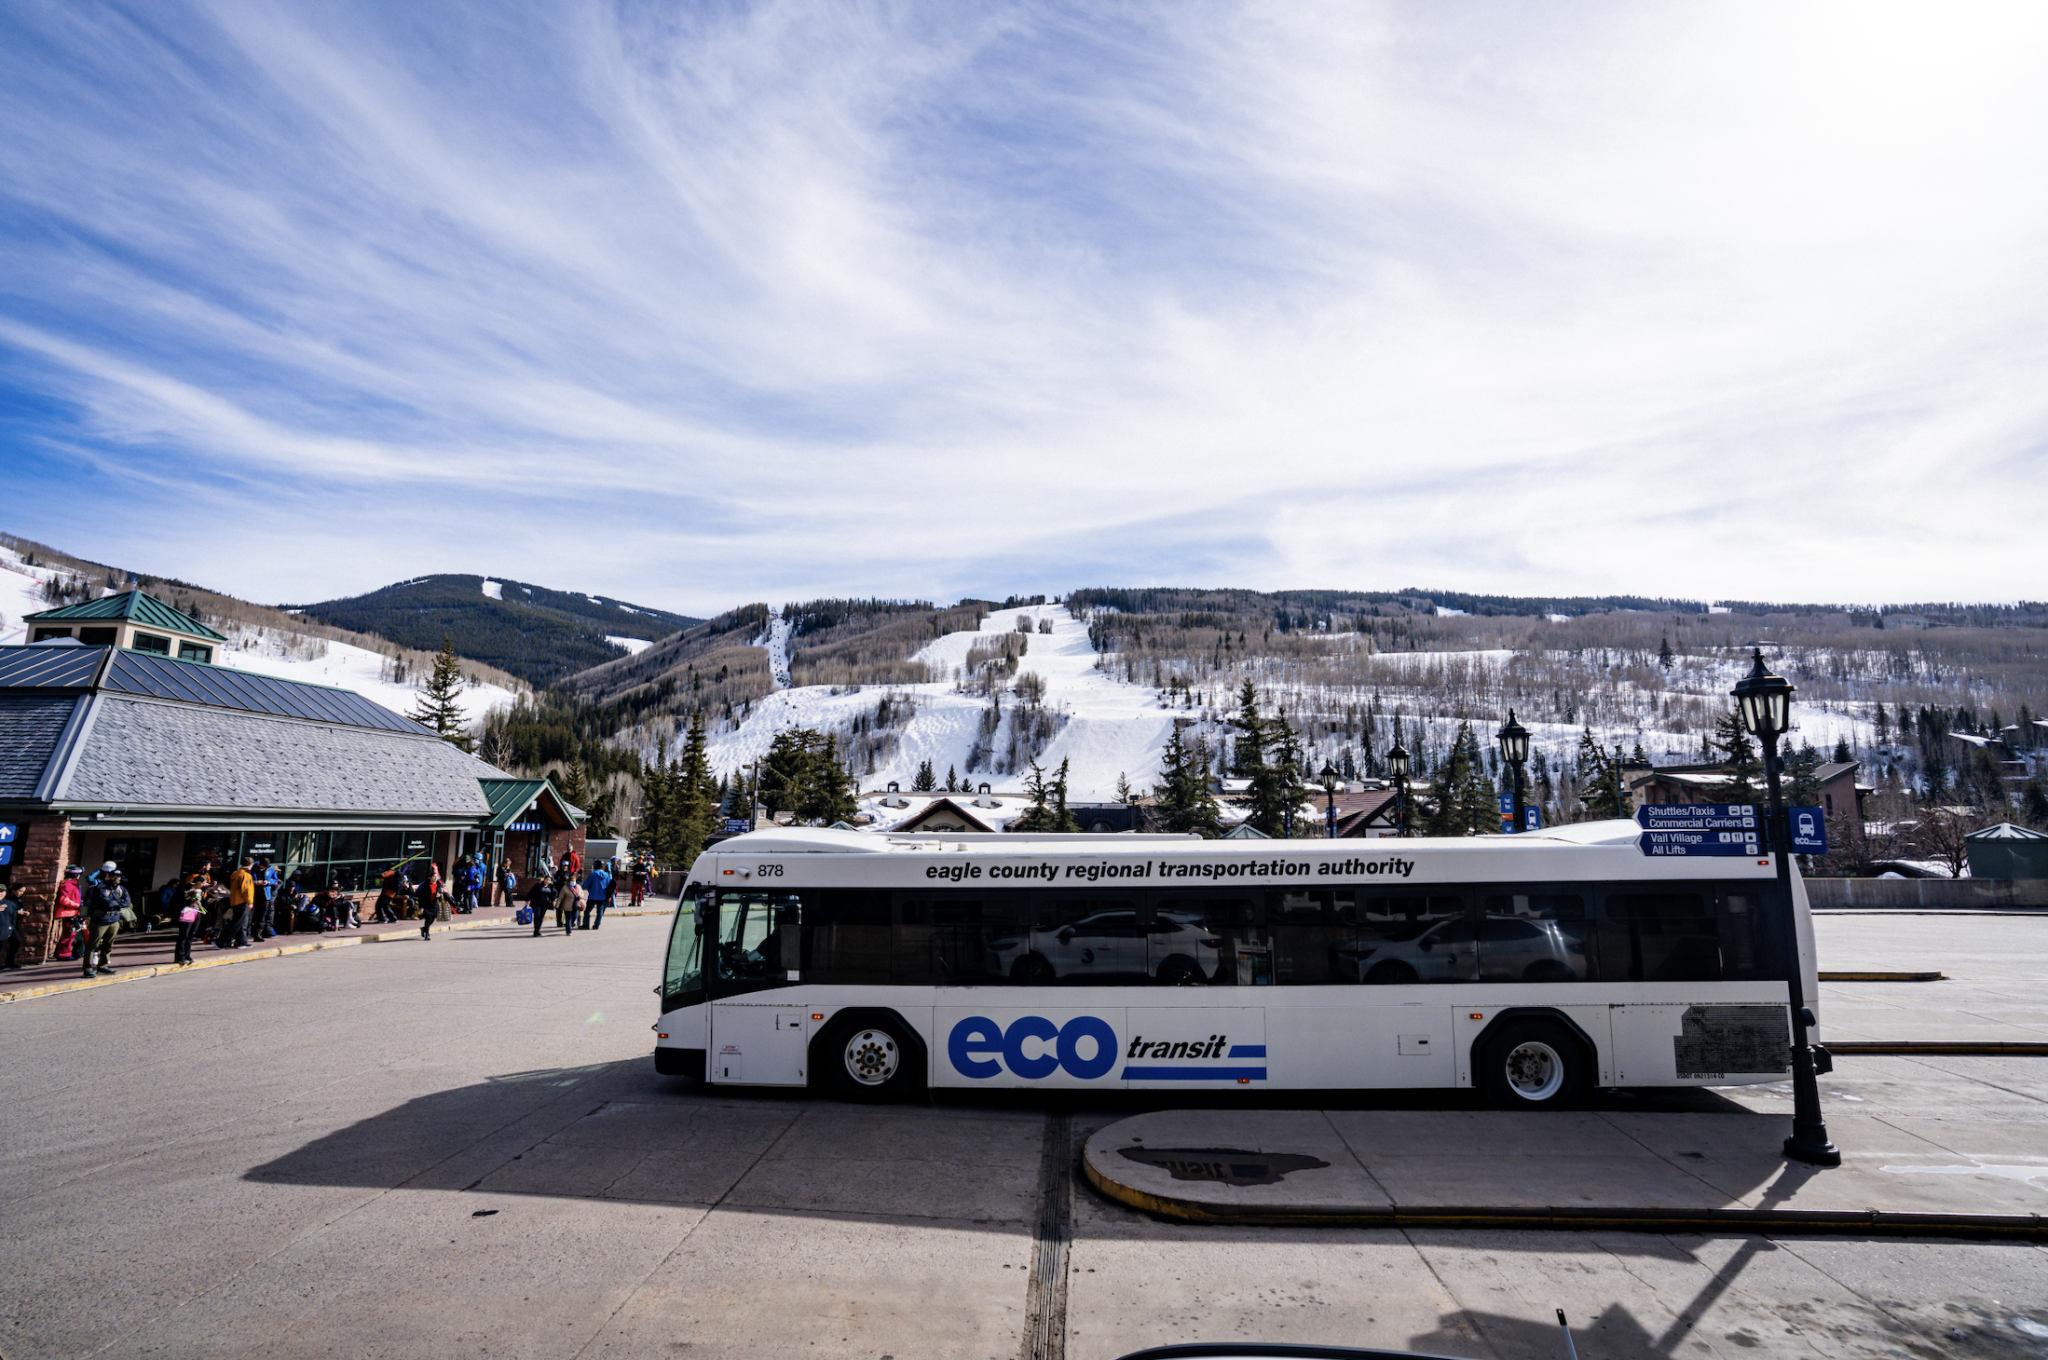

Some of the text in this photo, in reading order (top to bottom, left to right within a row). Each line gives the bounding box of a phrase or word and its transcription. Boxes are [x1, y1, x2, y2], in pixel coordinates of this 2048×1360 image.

[1648, 806, 1715, 816] Shuttles/Taxis
[1649, 817, 1742, 828] Commercial Carriers
[1651, 833, 1703, 844] Vail Village
[1794, 837, 1809, 845] eco
[1652, 845, 1686, 854] All Lifts
[757, 864, 784, 877] 878
[925, 858, 1415, 882] eagle county regional transportation authority
[947, 1015, 1227, 1080] eco transit
